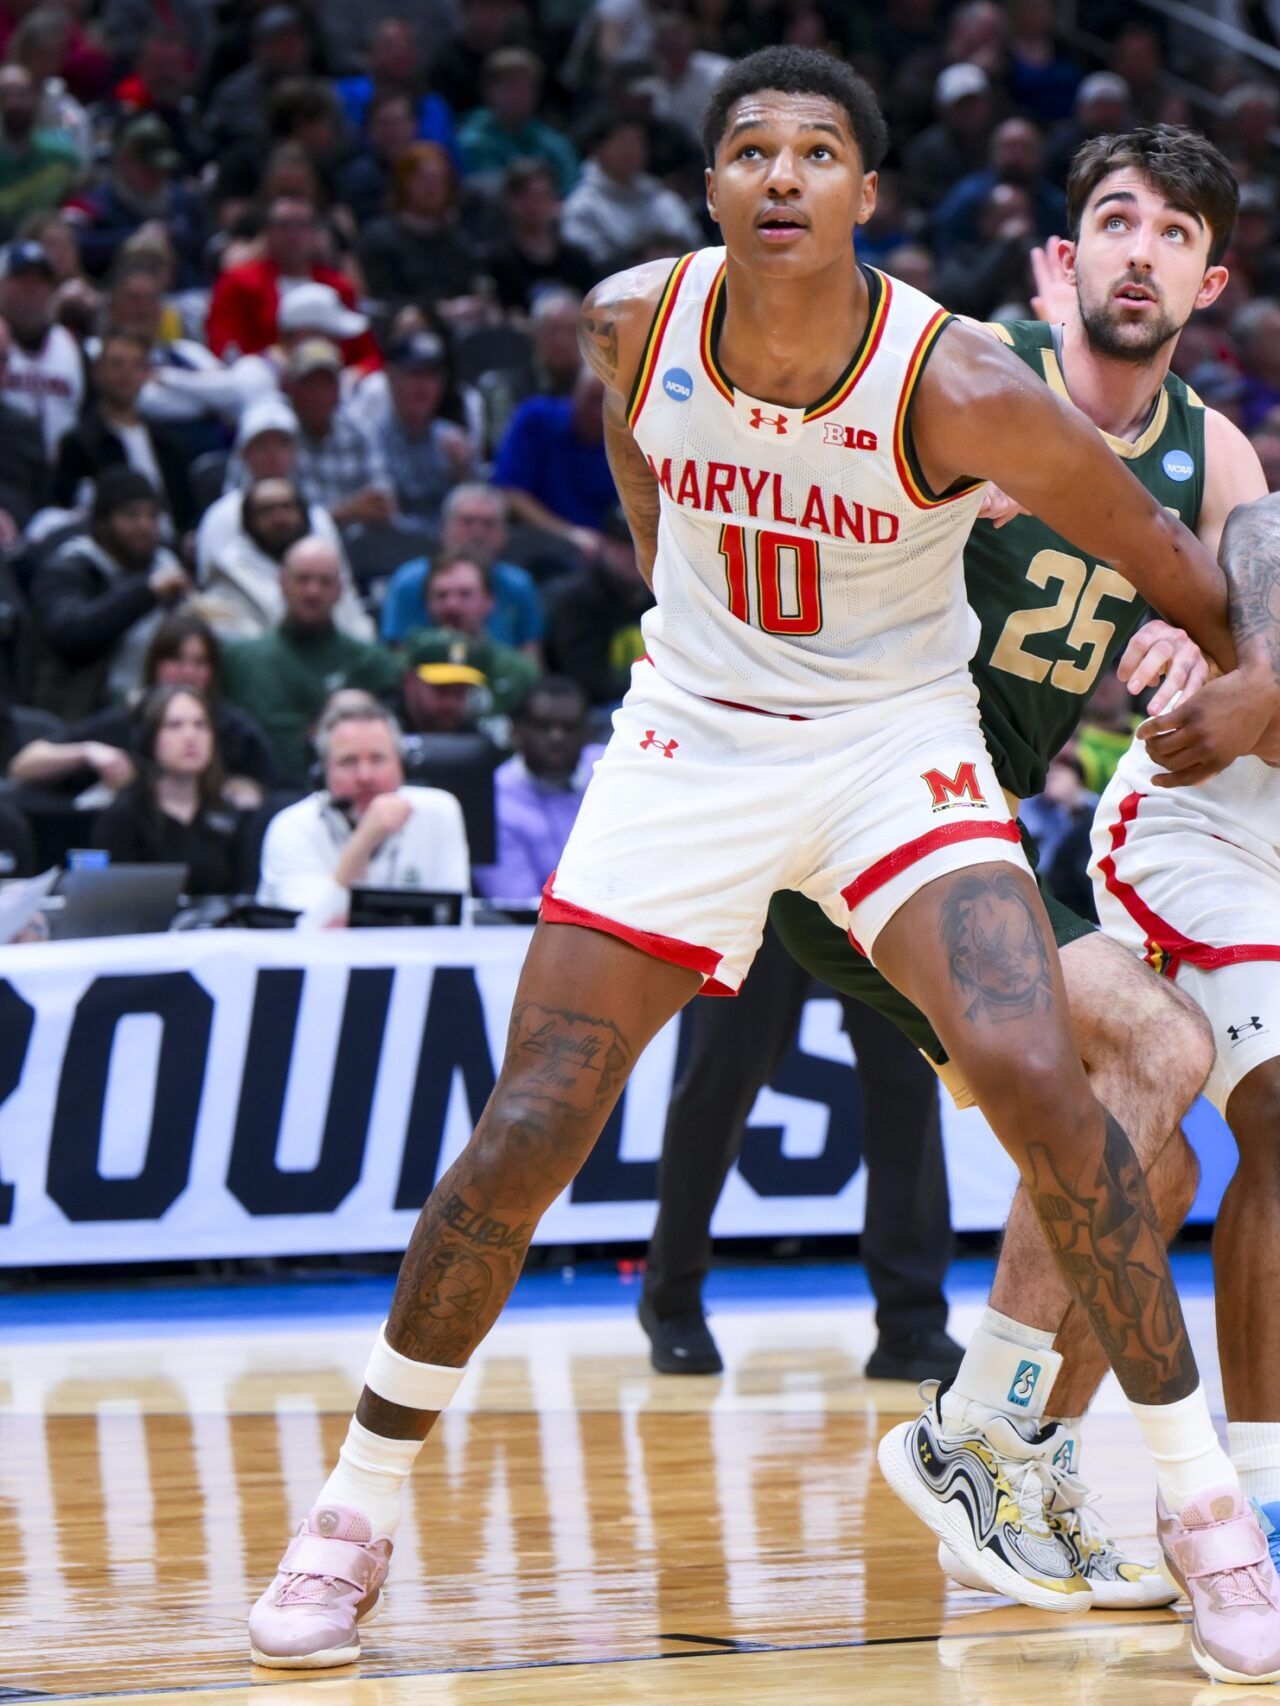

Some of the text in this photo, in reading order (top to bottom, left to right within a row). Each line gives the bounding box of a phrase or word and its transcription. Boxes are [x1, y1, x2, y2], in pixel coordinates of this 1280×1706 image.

[665, 380, 690, 397] NCAA
[647, 454, 899, 545] MARYLAND
[718, 523, 823, 636] 10
[989, 549, 1138, 695] 25
[920, 761, 987, 808] M
